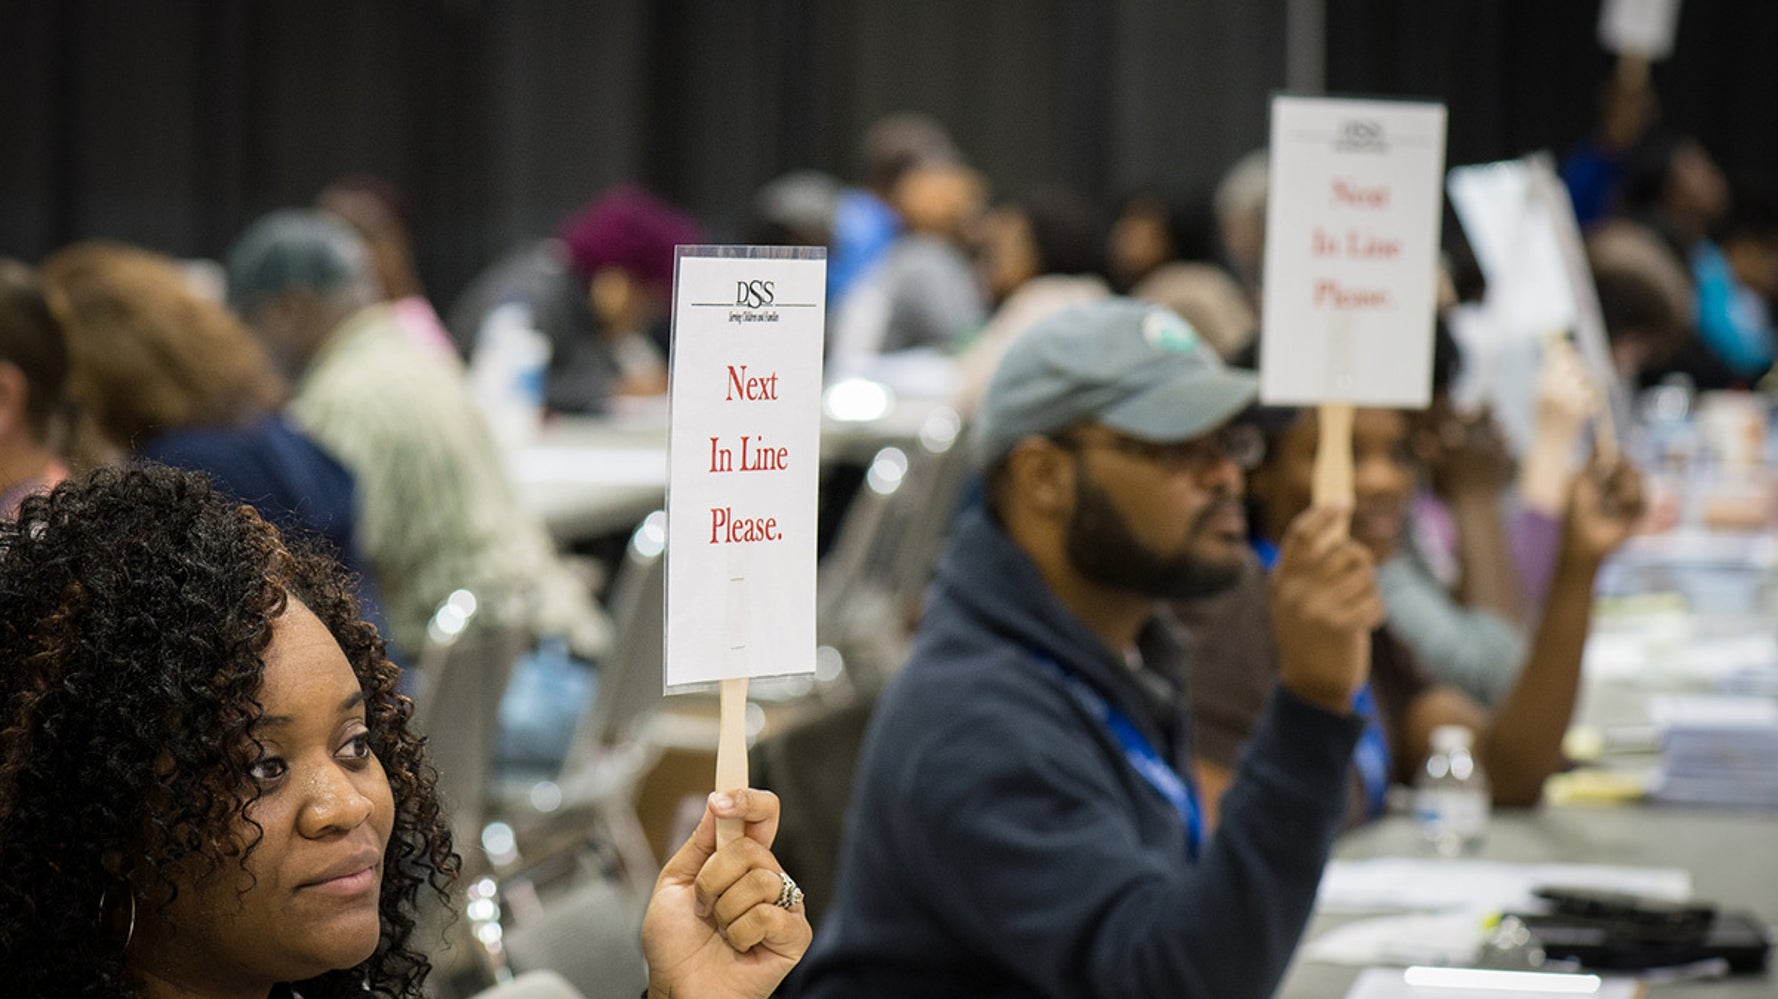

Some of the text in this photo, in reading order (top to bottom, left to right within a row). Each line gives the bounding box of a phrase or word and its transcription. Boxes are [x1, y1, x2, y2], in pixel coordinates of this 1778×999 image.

[737, 280, 774, 309] DSS
[725, 364, 778, 401] Next
[709, 435, 788, 473] In Line
[709, 507, 783, 544] Please.
